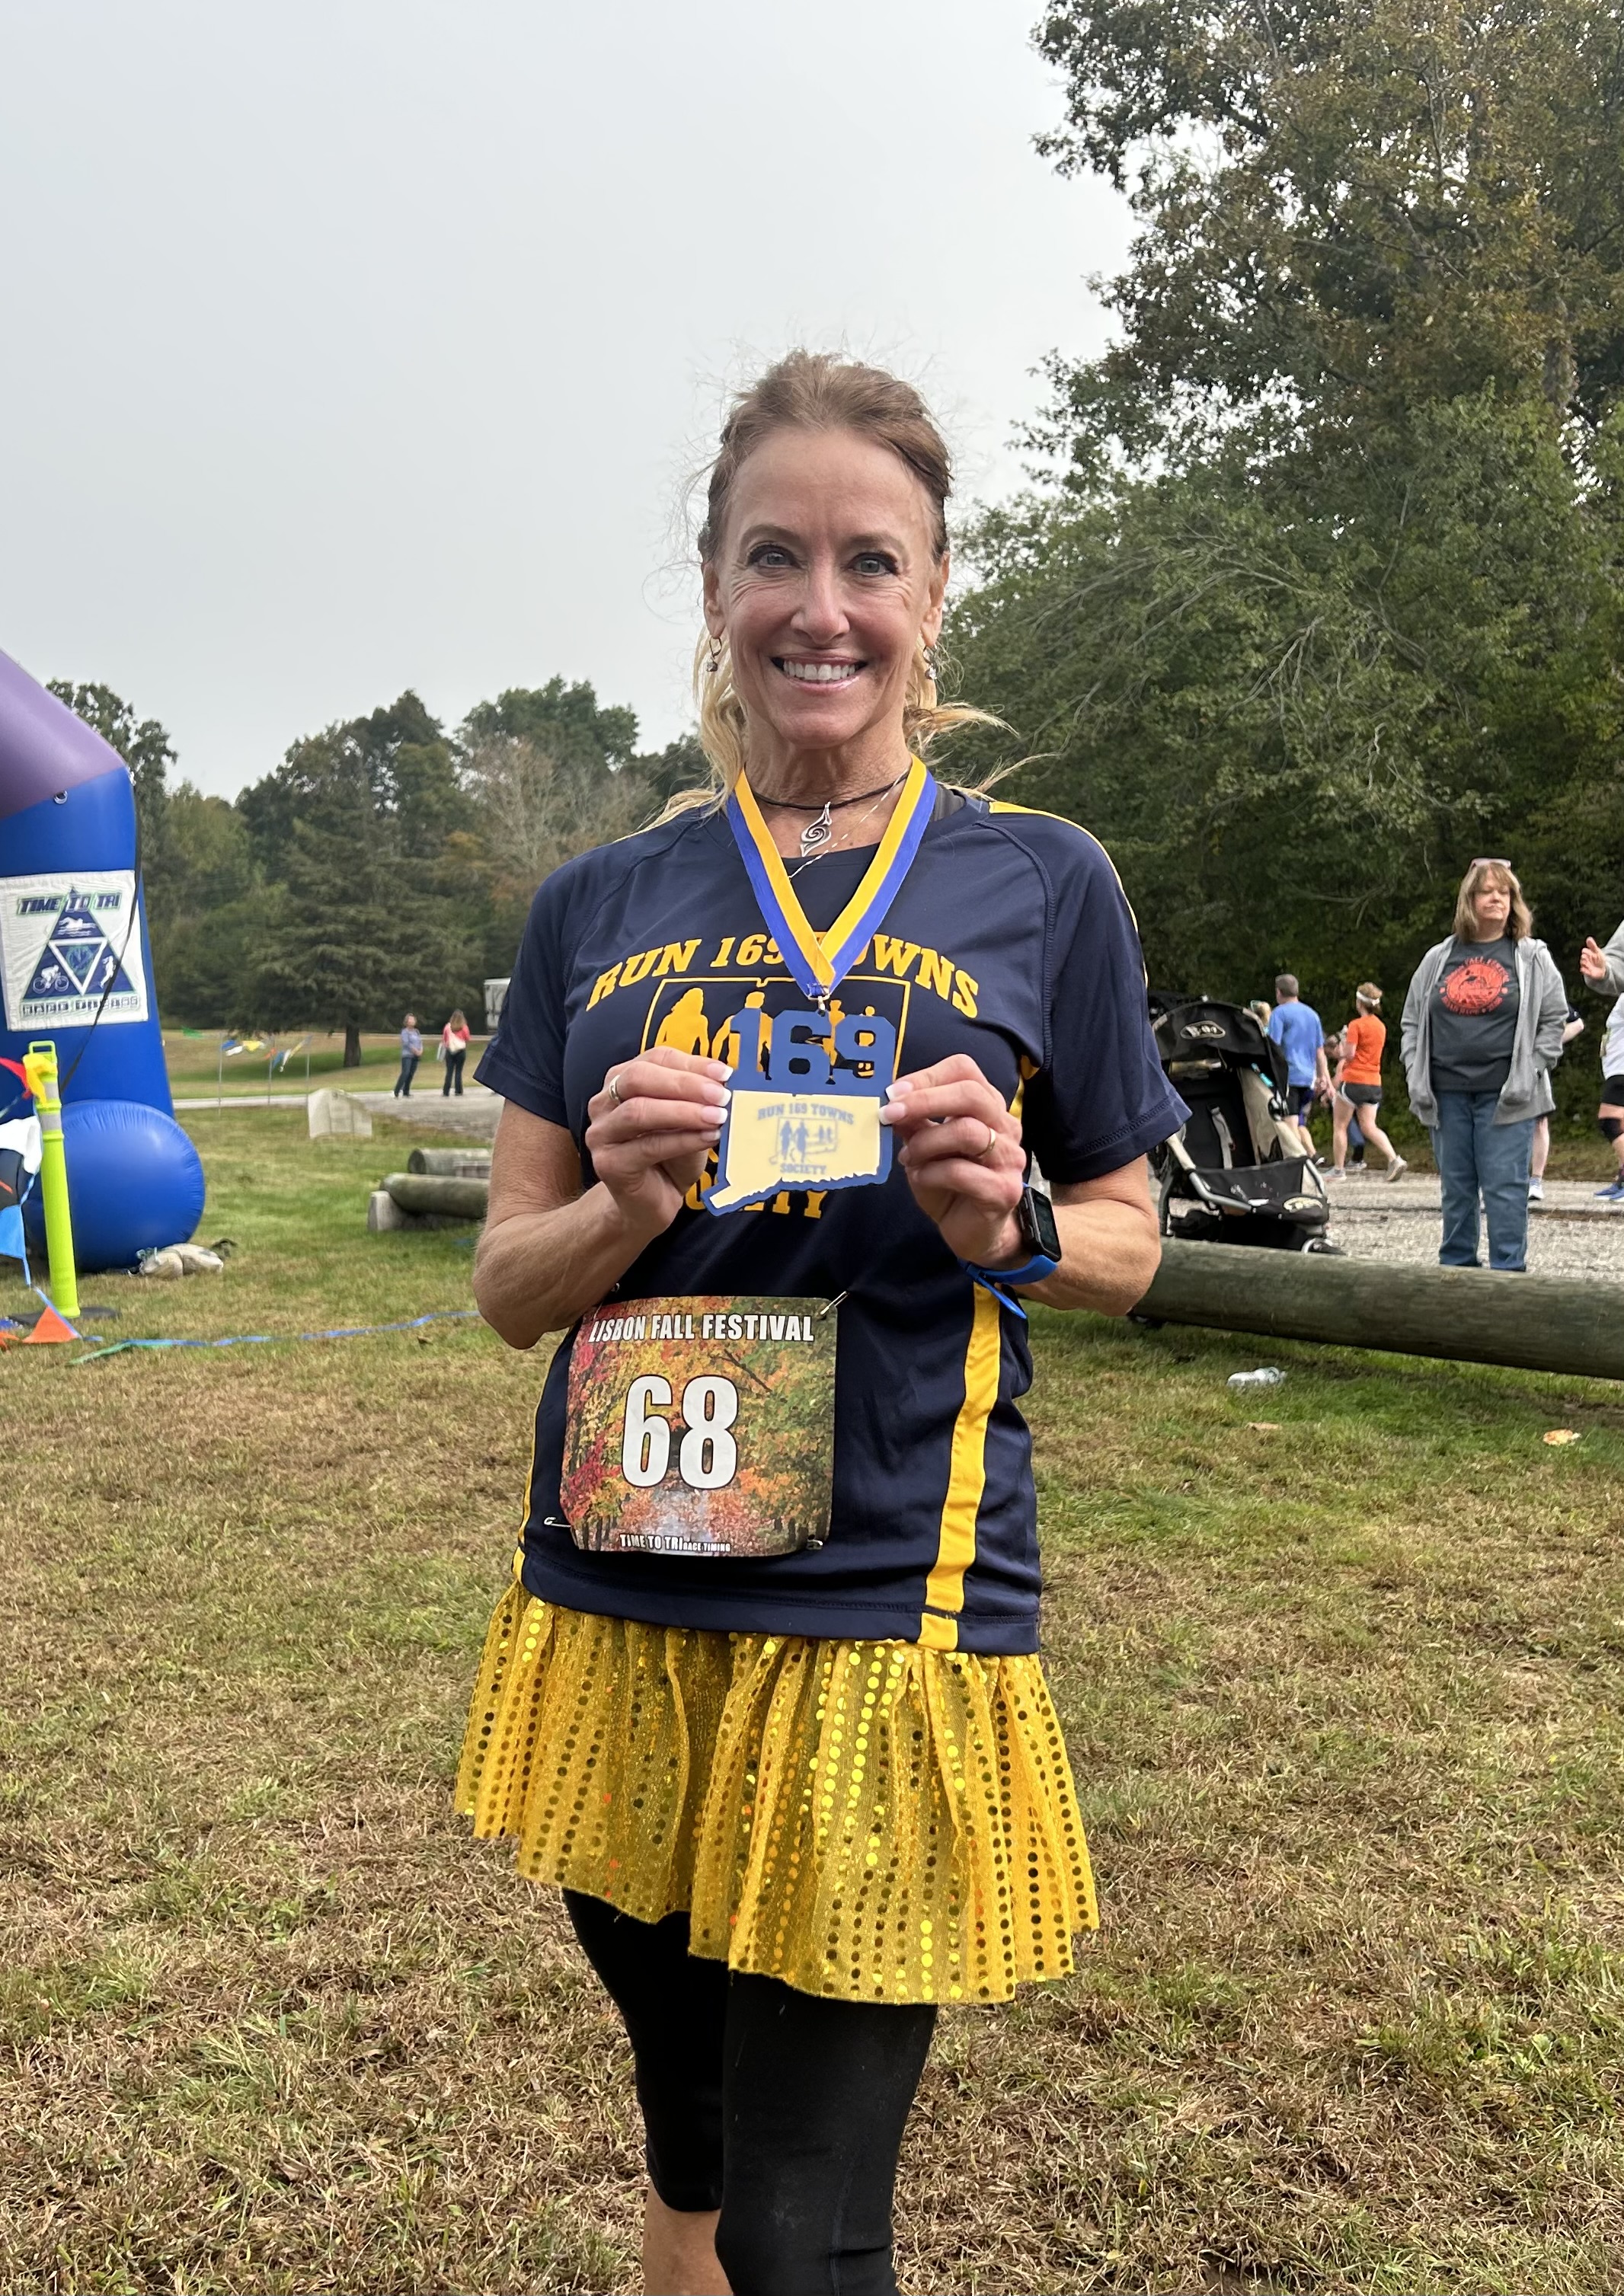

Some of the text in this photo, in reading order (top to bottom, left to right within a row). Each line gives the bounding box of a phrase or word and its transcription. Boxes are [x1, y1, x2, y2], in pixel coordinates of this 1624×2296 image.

[19, 893, 121, 914] TIME TO TRI
[586, 938, 702, 1012] RUN
[814, 931, 980, 1019] WNS
[728, 1007, 897, 1085] 169
[757, 1103, 854, 1125] RUN 169 TOWNS
[780, 1163, 826, 1174] SOCIETY
[588, 1314, 815, 1343] LISBON FALL FESTIVAL
[621, 1375, 738, 1490] 68
[619, 1534, 646, 1548] TIME
[647, 1534, 662, 1550] TO
